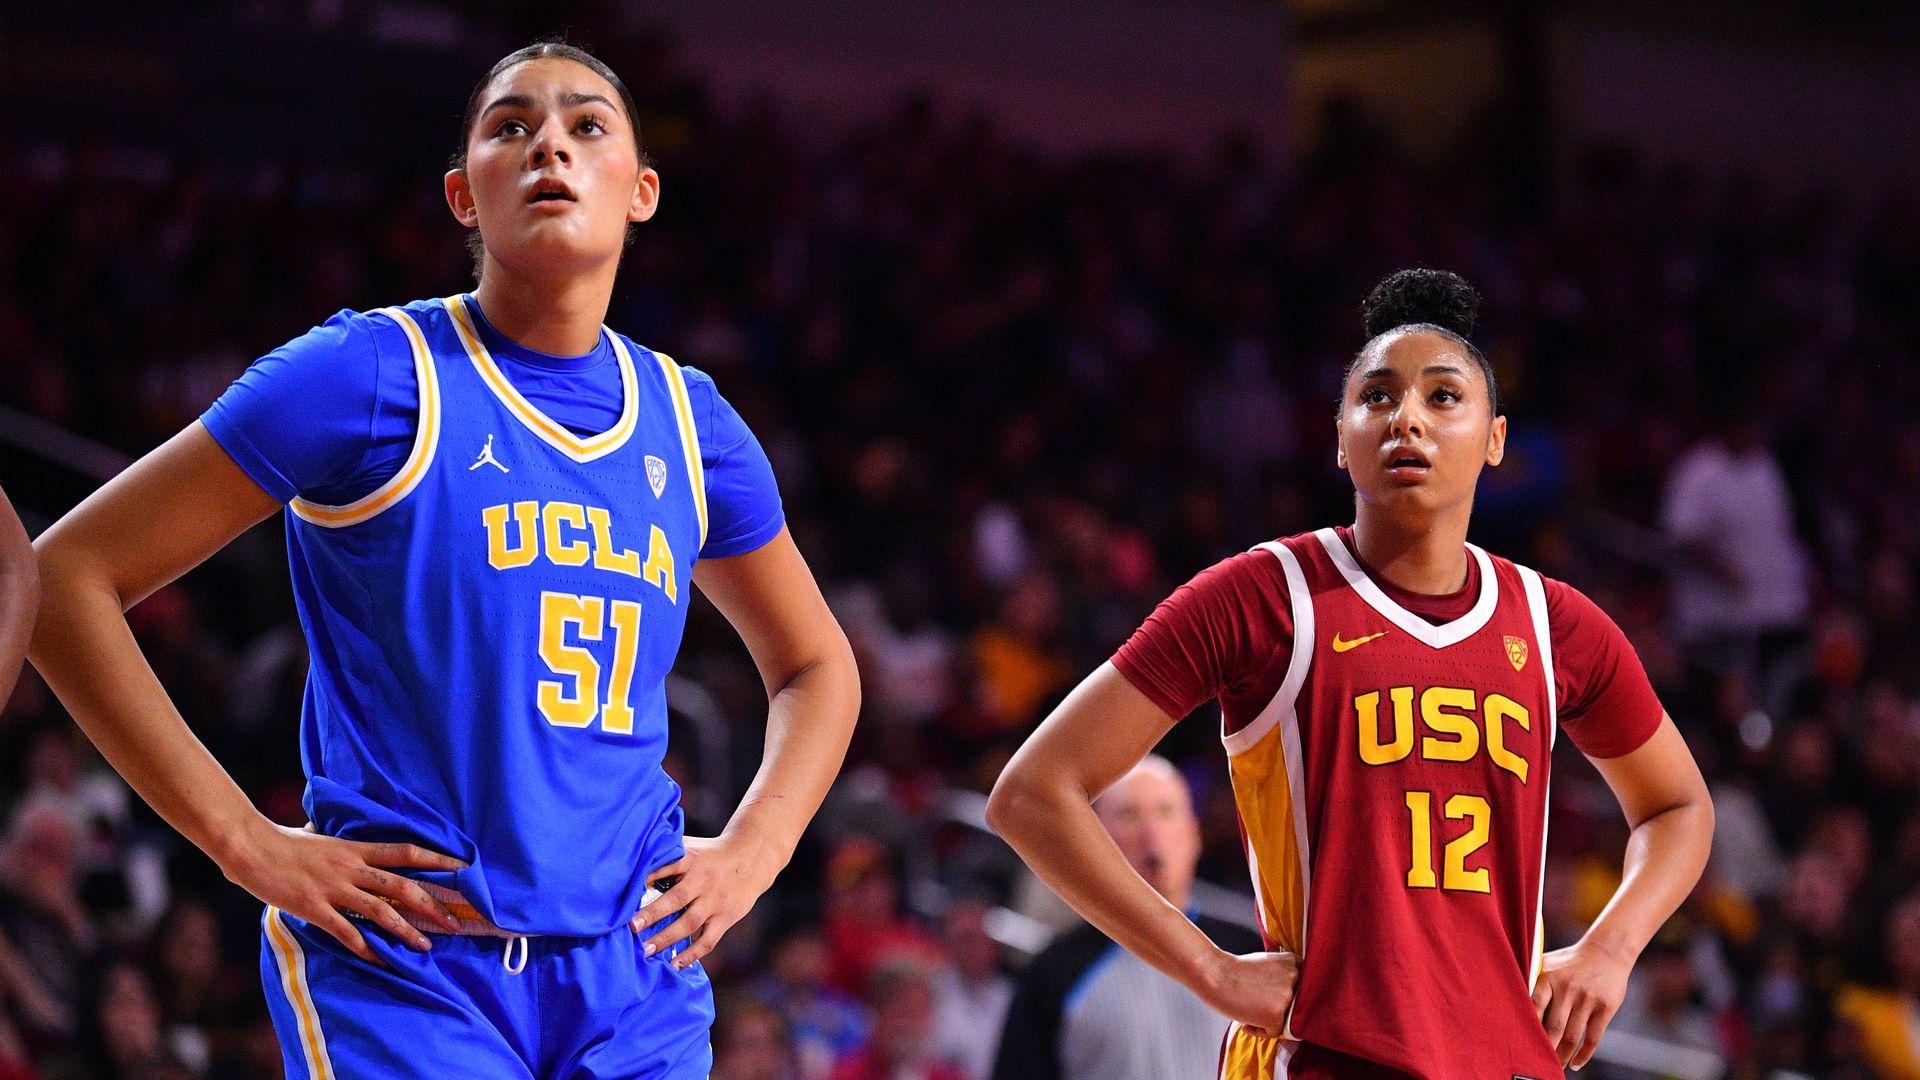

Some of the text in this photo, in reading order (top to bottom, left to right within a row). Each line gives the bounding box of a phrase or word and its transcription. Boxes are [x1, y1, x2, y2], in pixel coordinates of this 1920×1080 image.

[482, 501, 677, 606] UCLA
[537, 591, 641, 735] 51
[1505, 637, 1527, 657] PAC
[1511, 651, 1523, 664] 12
[1354, 685, 1531, 786] USC
[1404, 790, 1492, 894] 12
